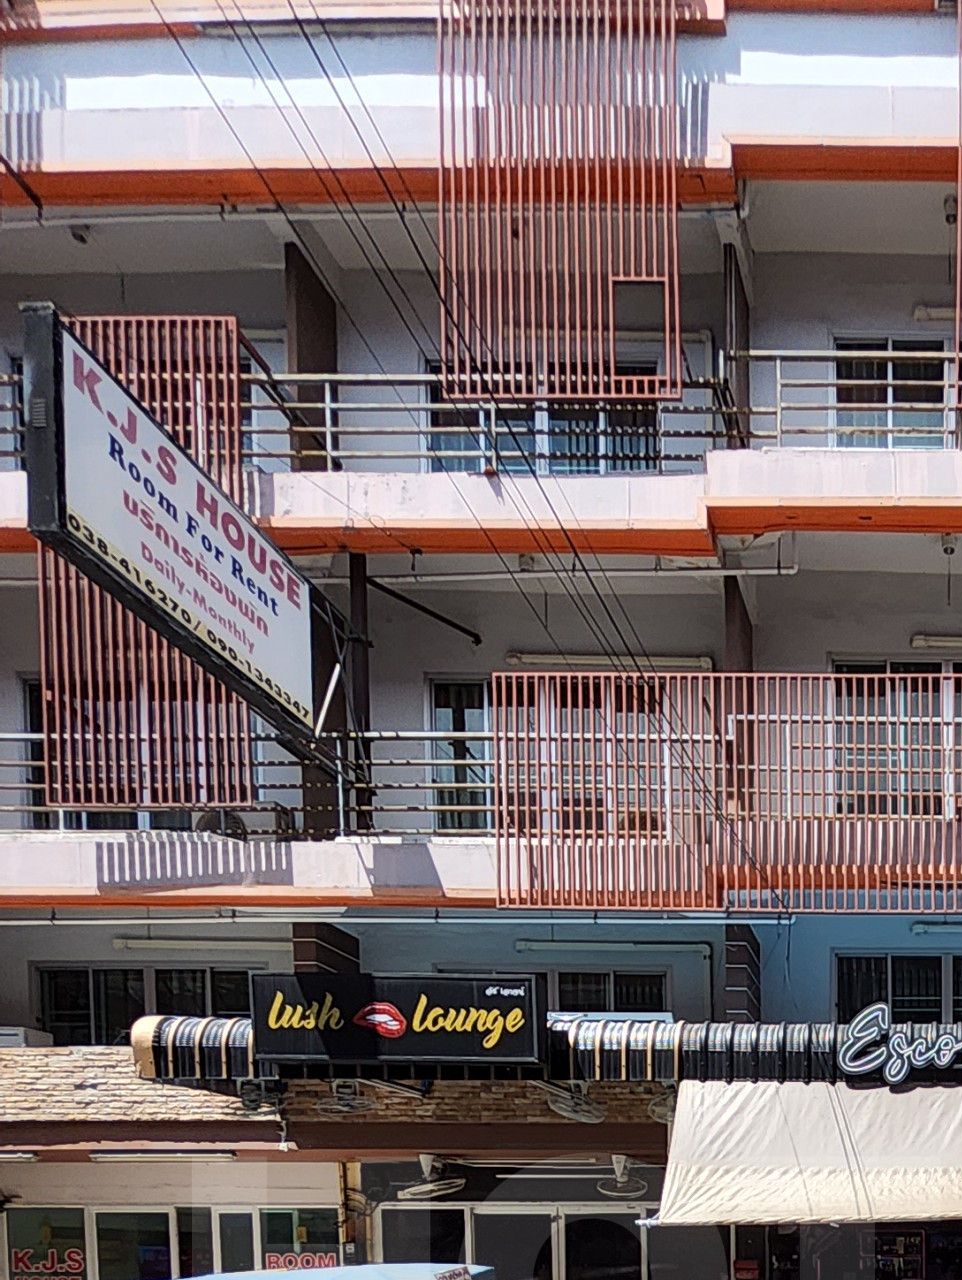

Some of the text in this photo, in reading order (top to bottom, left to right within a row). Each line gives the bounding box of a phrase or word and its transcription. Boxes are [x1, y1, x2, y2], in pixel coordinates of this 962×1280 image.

[72, 349, 301, 611] K.J.S HOUSE
[108, 432, 279, 616] Room For Rent
[141, 541, 255, 655] Daily-Monthly
[268, 990, 526, 1049] lush lounge
[12, 1248, 85, 1273] K.J.S
[265, 1252, 337, 1270] ROOM
